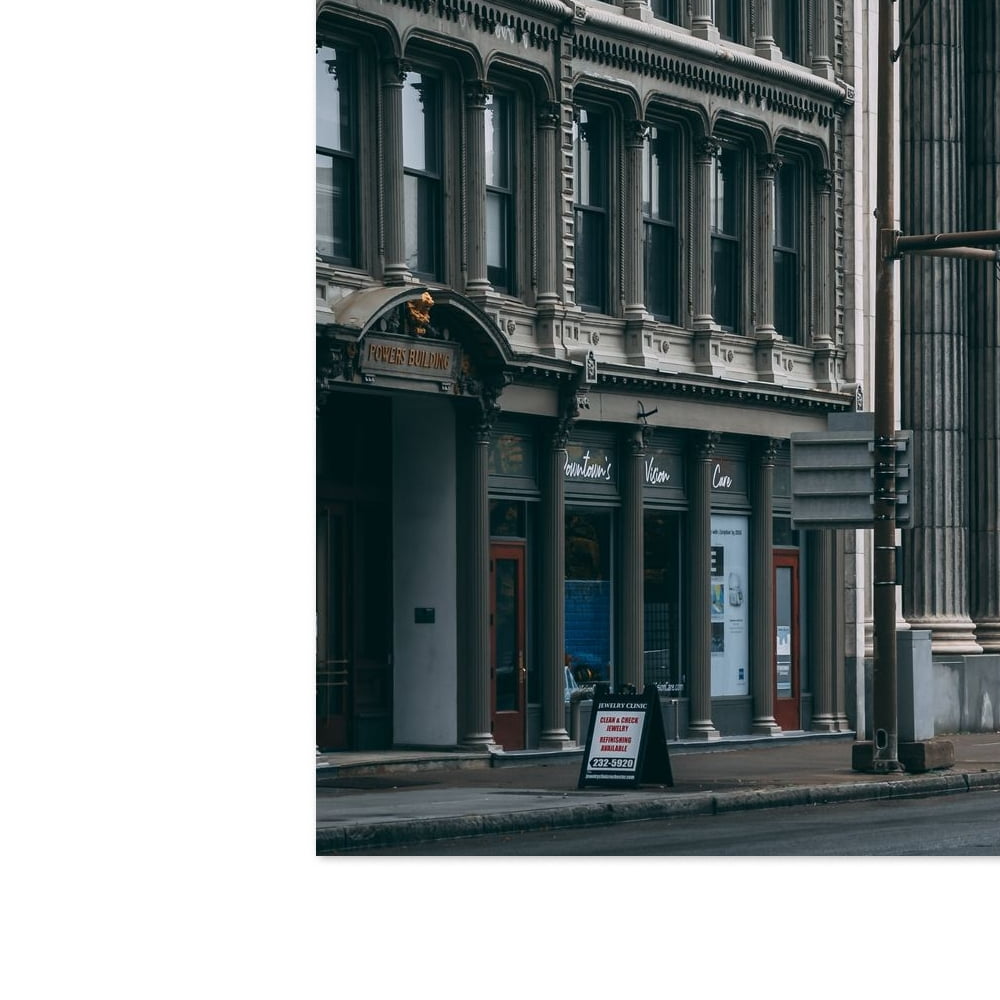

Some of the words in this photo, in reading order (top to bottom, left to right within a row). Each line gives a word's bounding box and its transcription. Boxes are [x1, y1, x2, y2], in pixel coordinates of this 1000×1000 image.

[368, 343, 406, 365] POWERS
[407, 350, 450, 370] BUILDING
[645, 456, 671, 484] Vision
[712, 464, 733, 488] Care
[600, 716, 616, 724] CLEAN
[592, 758, 634, 768] 232-5920
